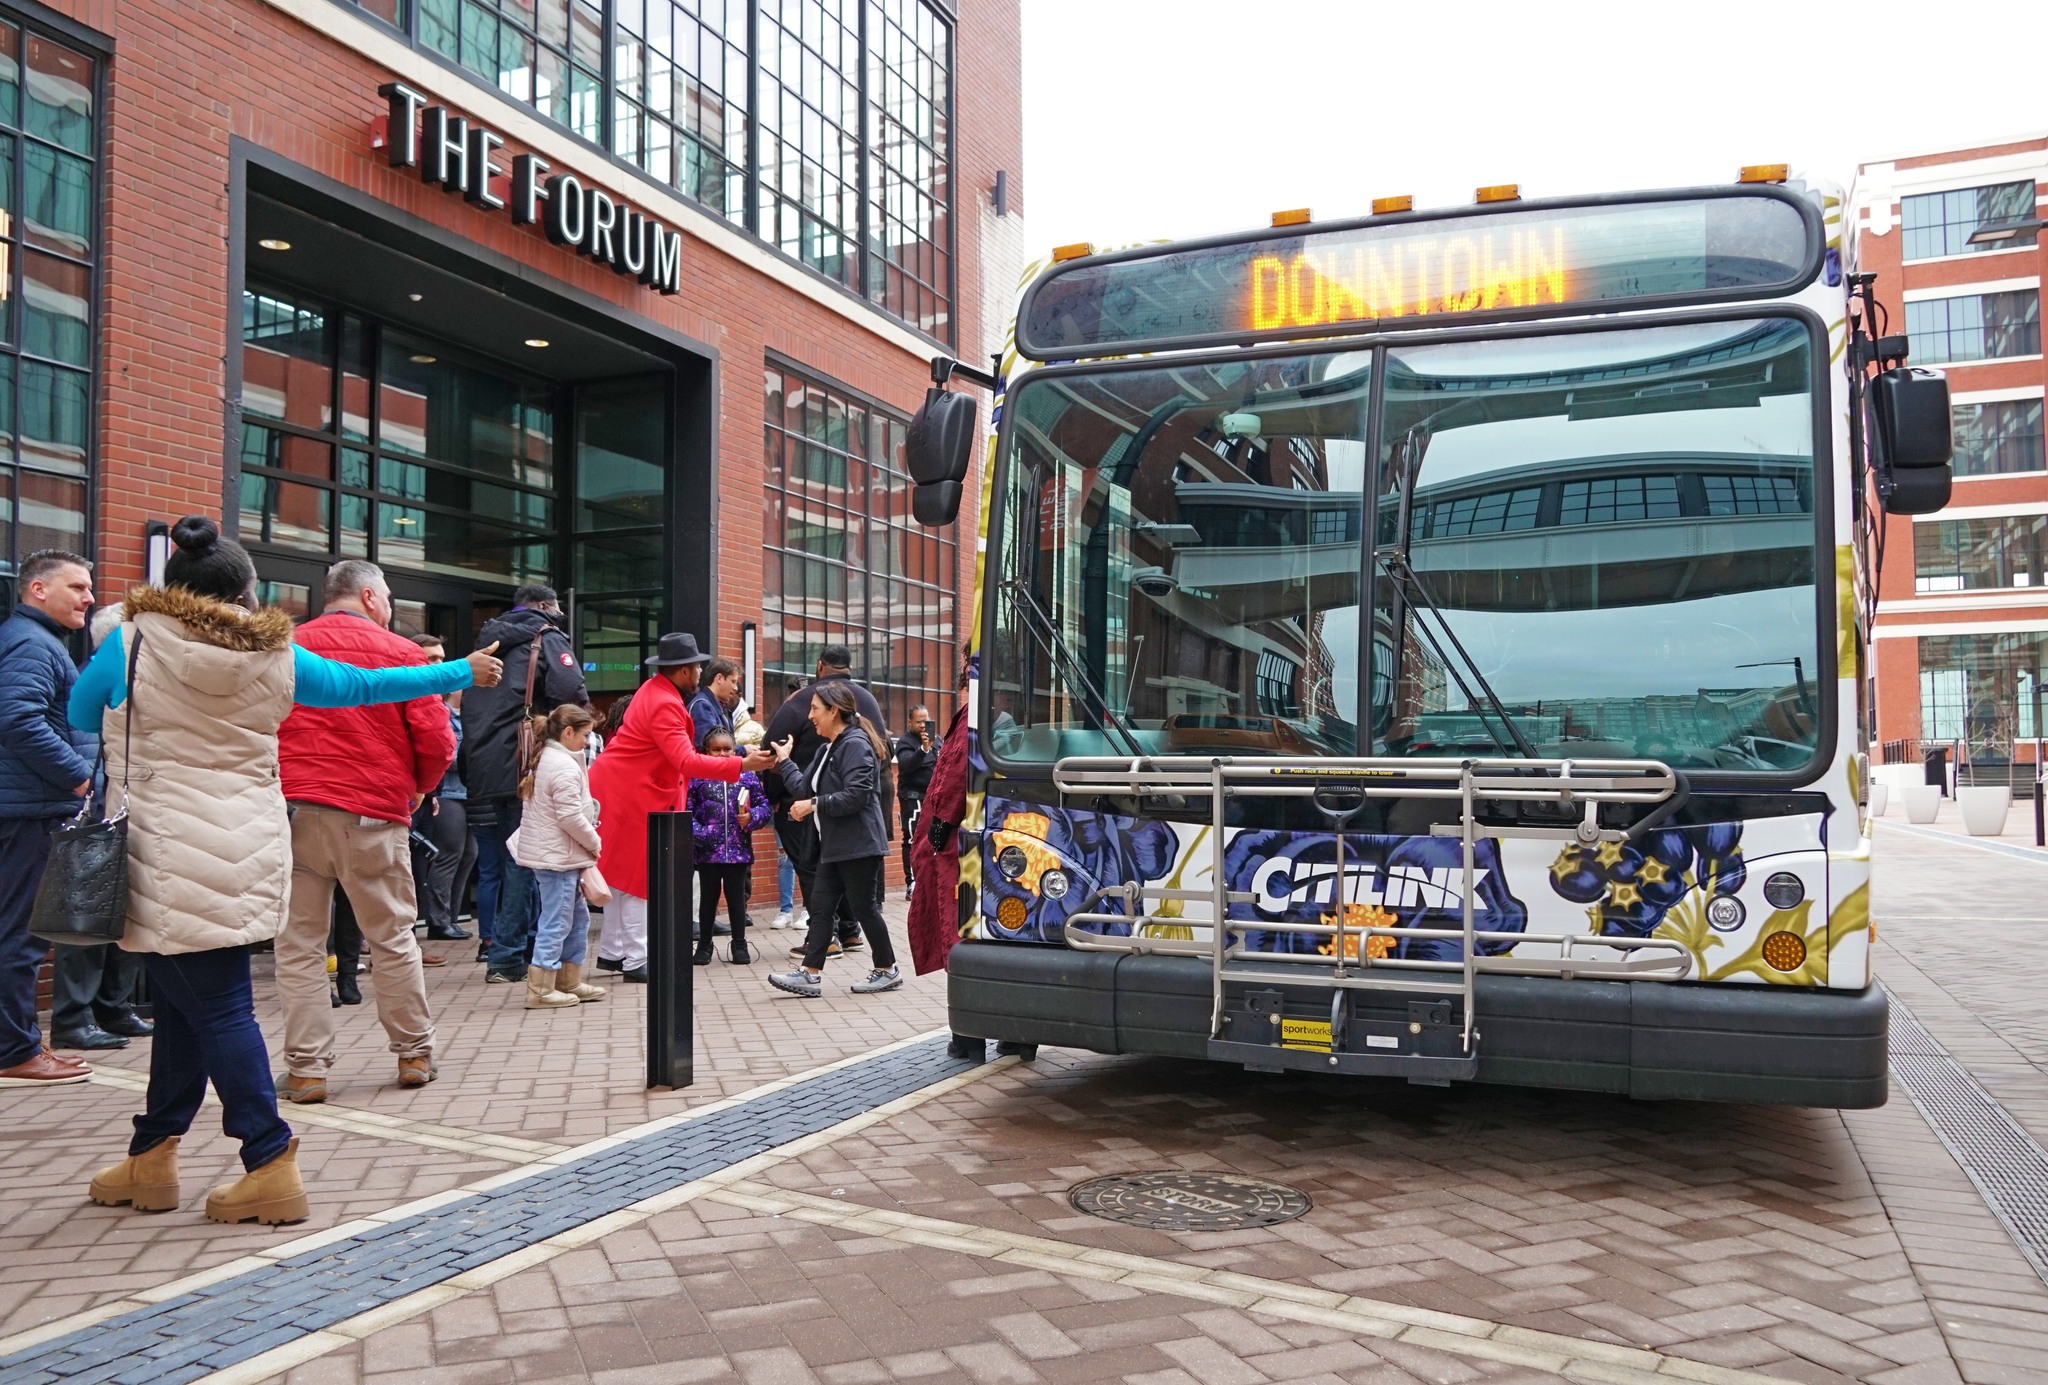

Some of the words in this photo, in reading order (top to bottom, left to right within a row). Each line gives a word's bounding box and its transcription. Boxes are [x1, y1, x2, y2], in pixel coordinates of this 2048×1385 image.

[392, 83, 505, 210] THE
[520, 154, 682, 295] FORUM
[1253, 226, 1563, 331] DOWNTOWN
[1251, 856, 1490, 913] CITILINK
[1283, 1025, 1332, 1036] sportworks
[1150, 1188, 1233, 1212] STORM
